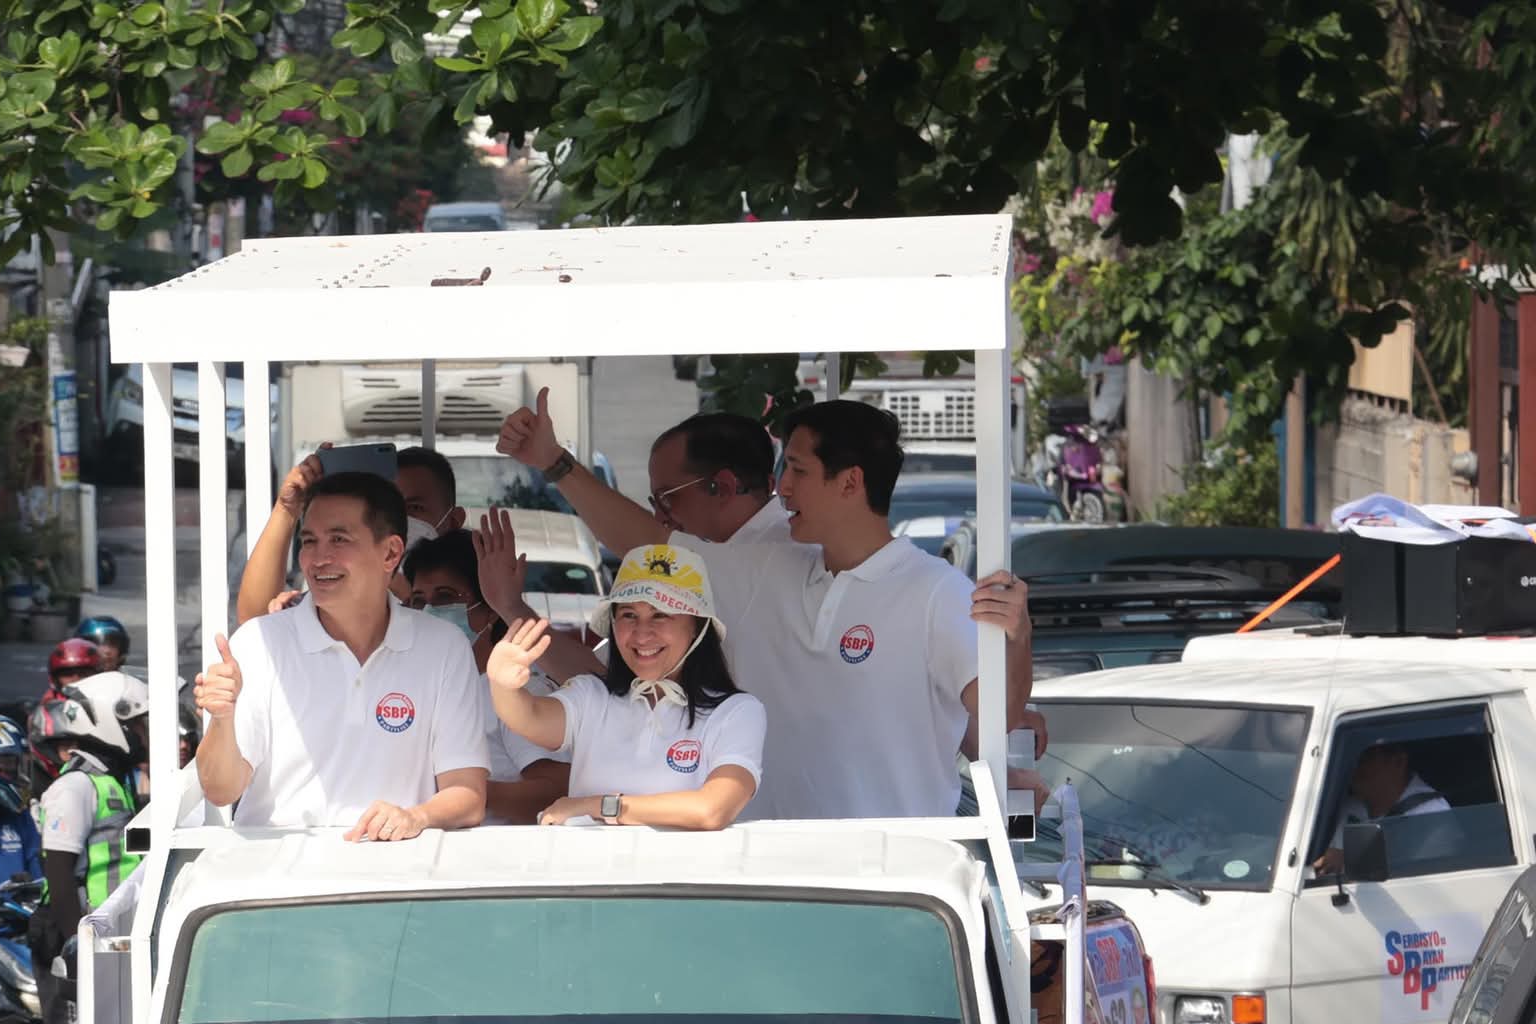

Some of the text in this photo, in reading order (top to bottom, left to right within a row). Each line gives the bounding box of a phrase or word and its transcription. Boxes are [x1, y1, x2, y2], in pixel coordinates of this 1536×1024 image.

[845, 637, 868, 651] SBP
[383, 705, 408, 719] SBP
[674, 749, 698, 761] SBP
